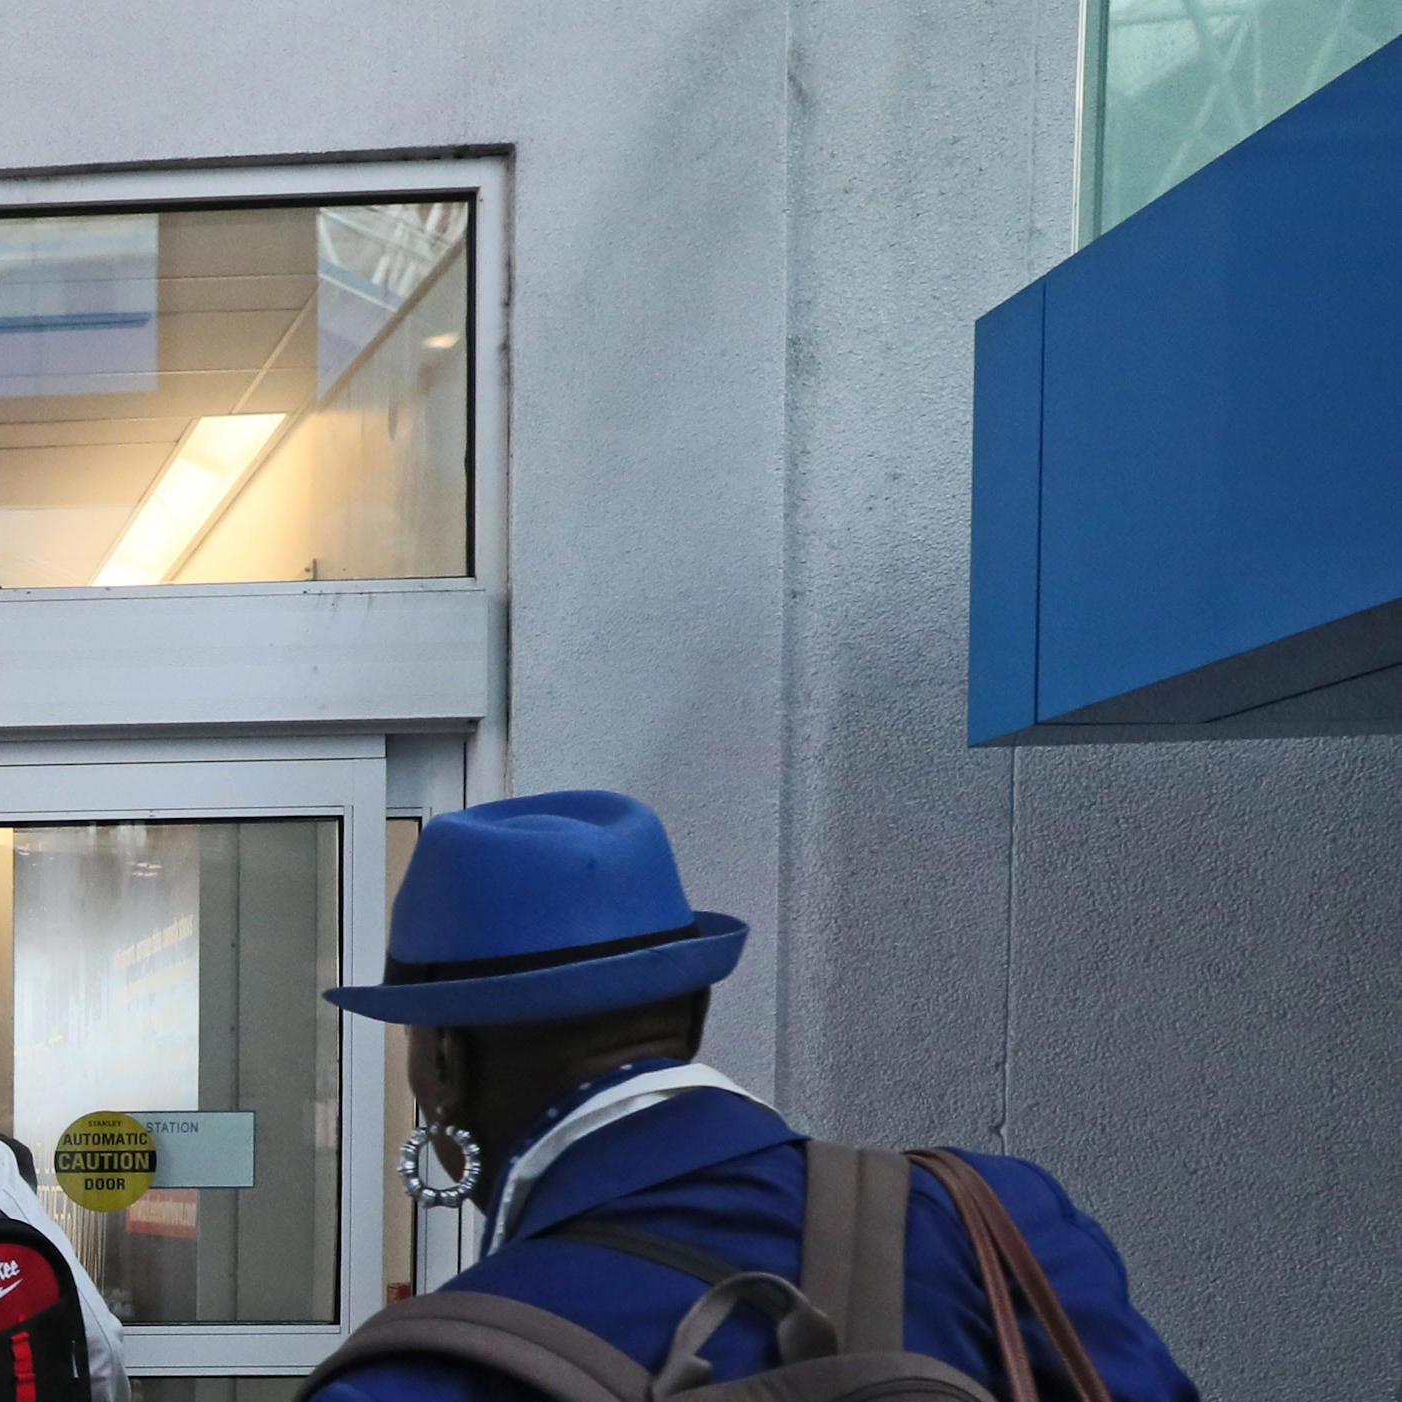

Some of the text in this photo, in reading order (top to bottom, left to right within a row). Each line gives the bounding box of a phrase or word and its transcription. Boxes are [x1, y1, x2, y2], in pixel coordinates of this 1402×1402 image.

[146, 1122, 199, 1134] STATION
[63, 1132, 147, 1146] AUTOMATIC
[58, 1152, 150, 1170] CAUTION
[85, 1178, 125, 1190] DOOR
